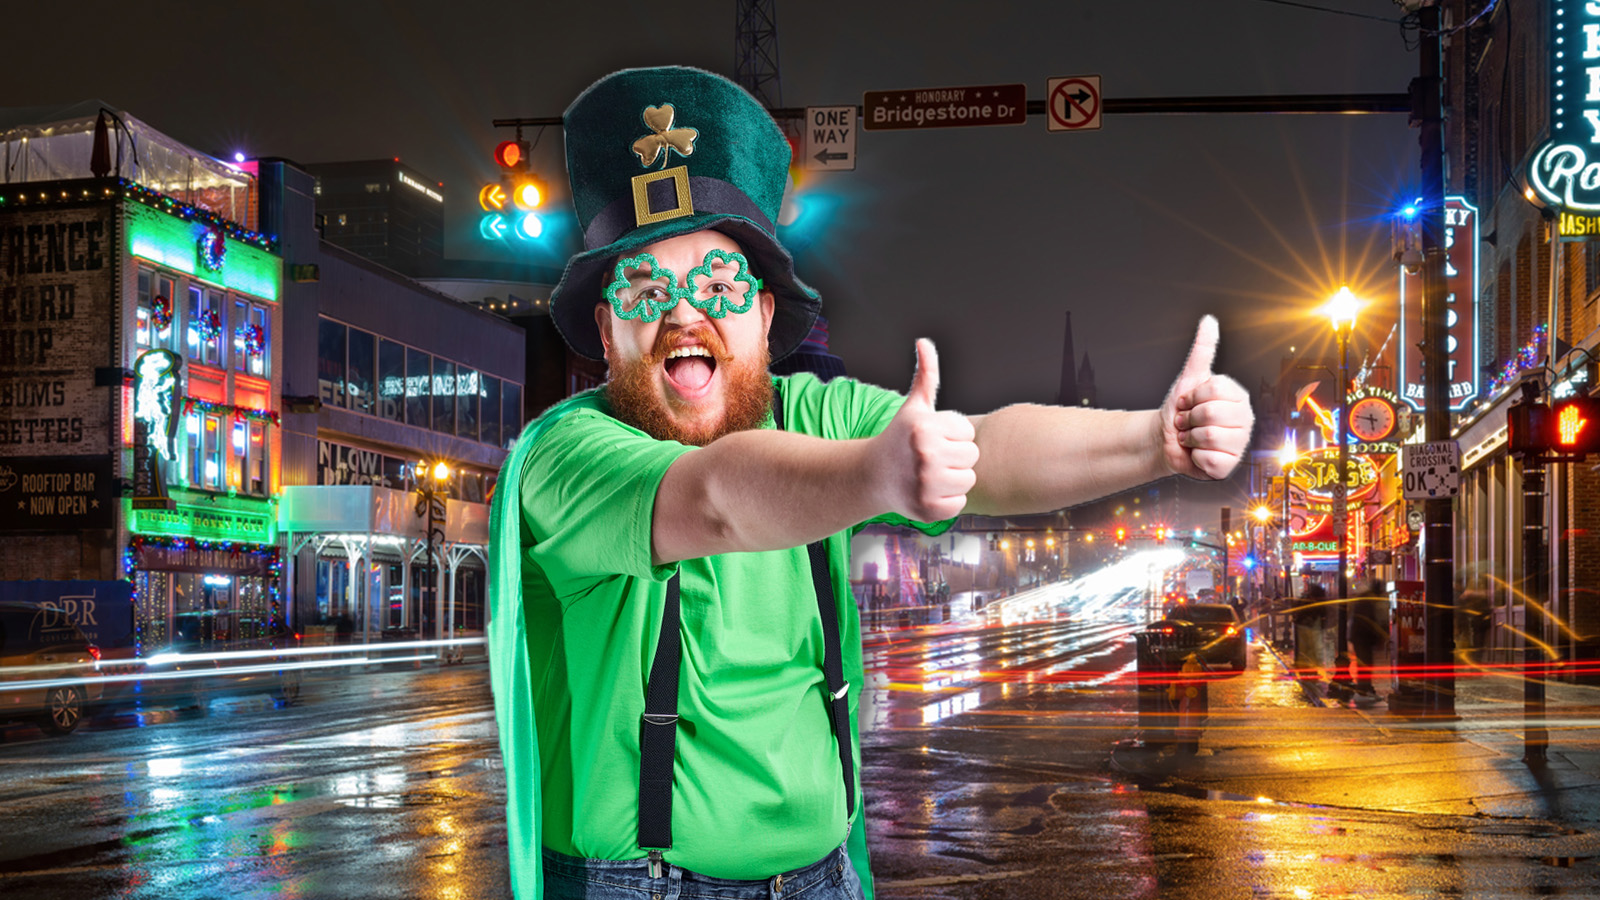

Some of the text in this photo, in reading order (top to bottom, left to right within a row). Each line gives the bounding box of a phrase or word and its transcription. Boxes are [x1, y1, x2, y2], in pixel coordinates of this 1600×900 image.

[915, 89, 966, 104] HONORARY
[815, 111, 849, 126] ONE
[873, 103, 1017, 126] Bridgestone Dr
[813, 128, 850, 144] WAY
[1348, 442, 1399, 454] BOOTS
[1409, 442, 1453, 457] DIAGONAL
[1410, 453, 1453, 468] CROSSING
[22, 473, 71, 493] ROOFTOP
[74, 472, 96, 491] BAR
[1405, 471, 1427, 492] OK
[30, 495, 87, 516] NOW OPEN
[40, 598, 99, 628] DPR
